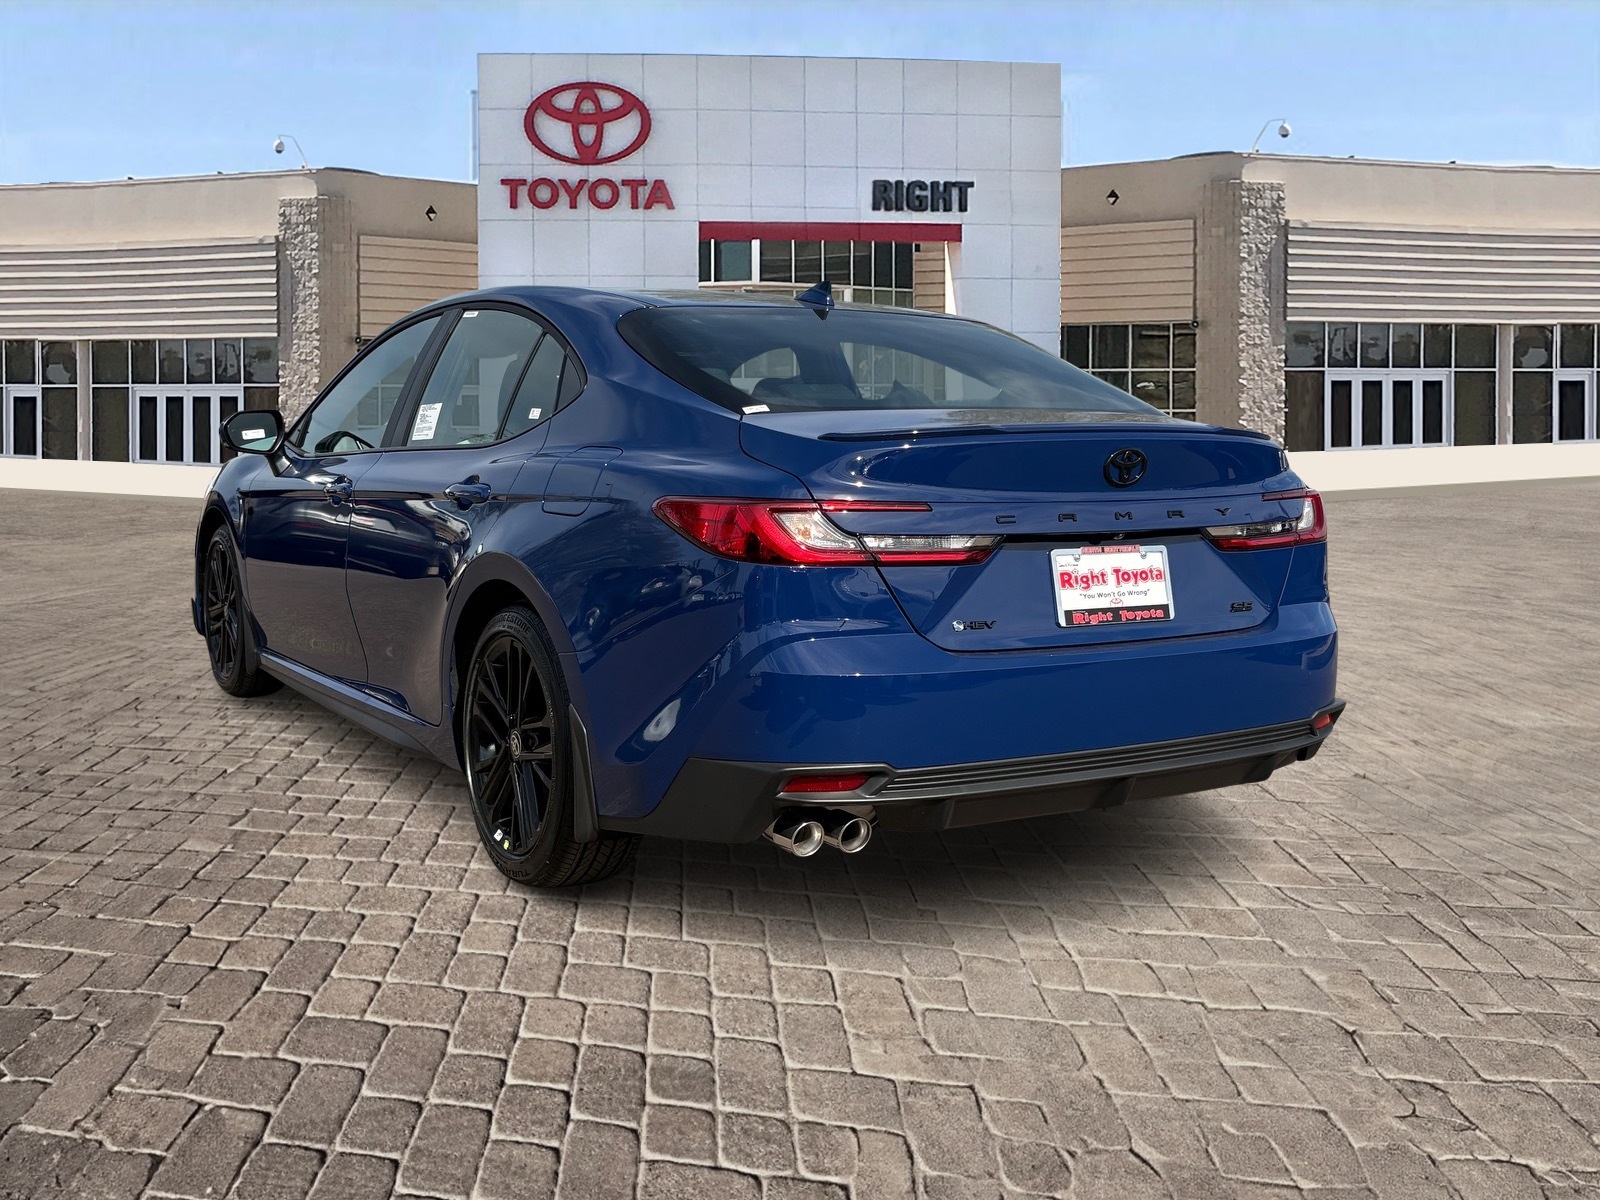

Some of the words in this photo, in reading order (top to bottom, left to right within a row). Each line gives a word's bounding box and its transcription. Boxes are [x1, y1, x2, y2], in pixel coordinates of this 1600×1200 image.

[500, 178, 675, 210] TOYOTA
[872, 179, 975, 213] RIGHT
[995, 507, 1231, 525] CAMRY
[1059, 570, 1108, 591] Right
[1112, 566, 1164, 586] Toyota
[963, 620, 997, 631] HEV
[1072, 611, 1113, 624] Right
[1120, 608, 1164, 622] Toyota
